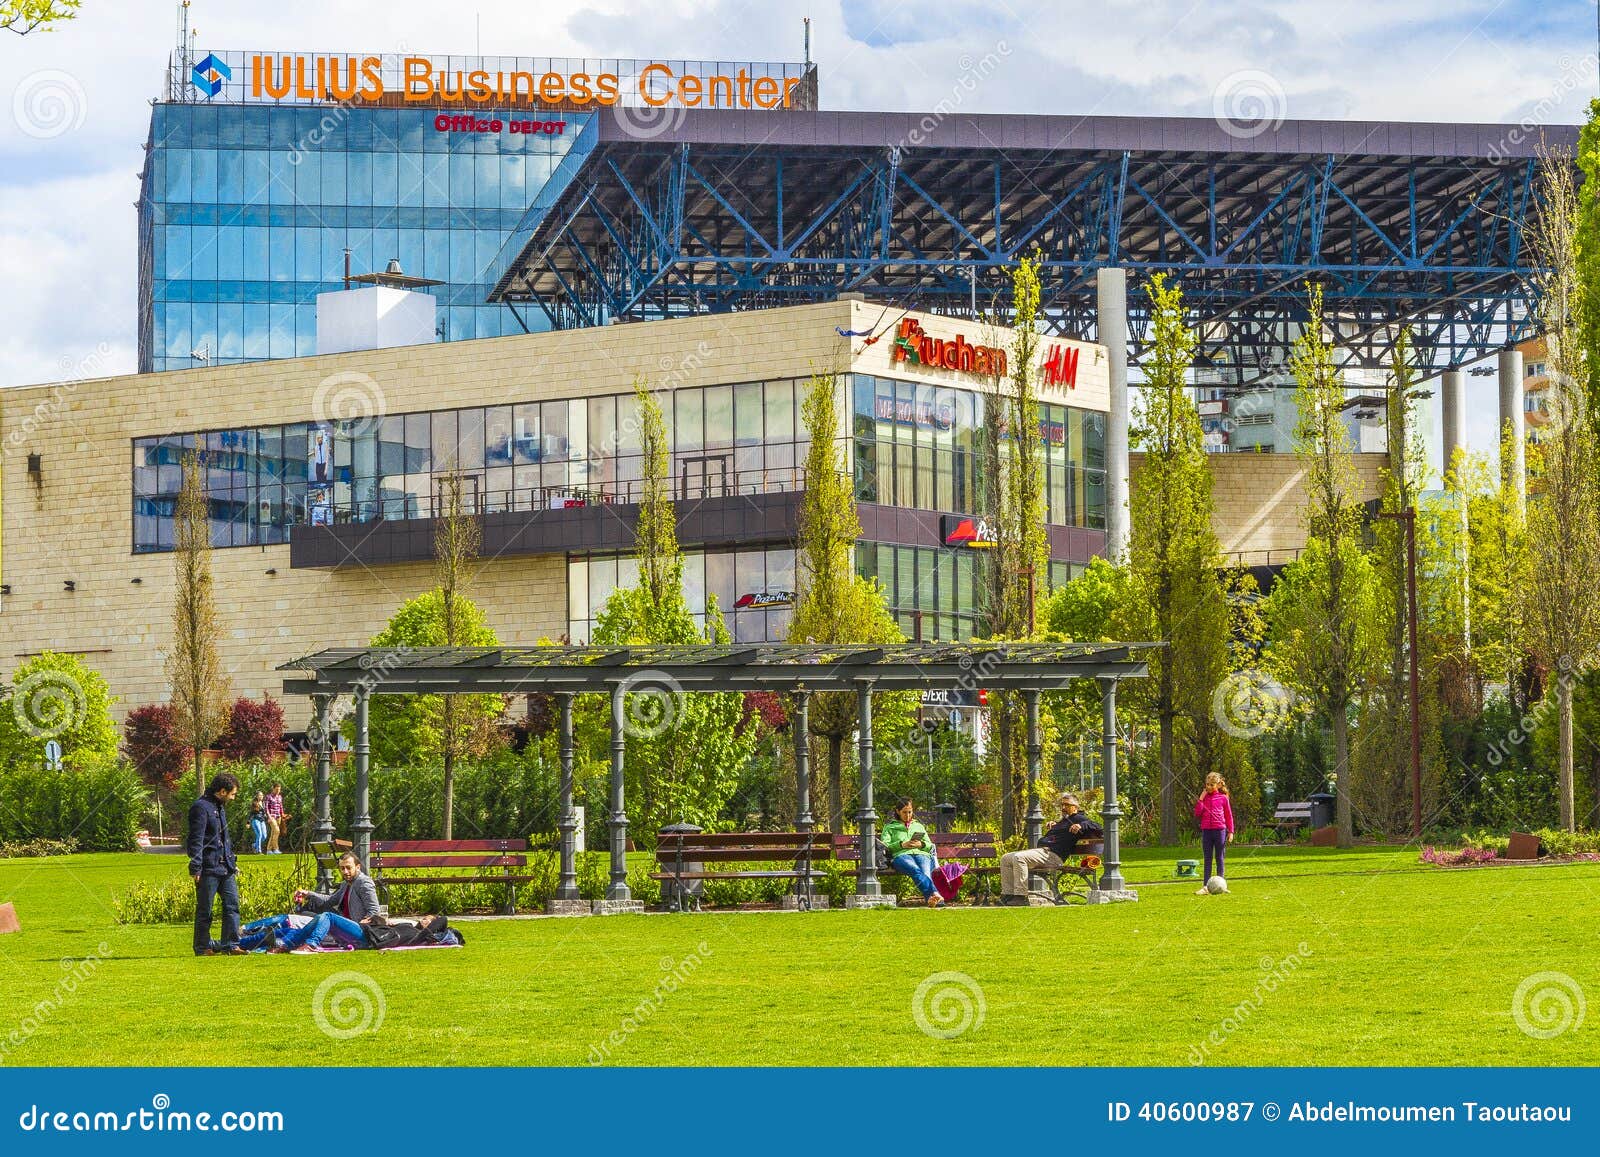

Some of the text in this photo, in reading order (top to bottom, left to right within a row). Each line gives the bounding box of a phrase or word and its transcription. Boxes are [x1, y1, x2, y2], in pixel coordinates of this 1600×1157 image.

[252, 55, 800, 109] IULIUS Business Center
[434, 114, 567, 135] Office DEPOT
[895, 317, 1008, 378] Auchan
[1044, 343, 1080, 390] H&M
